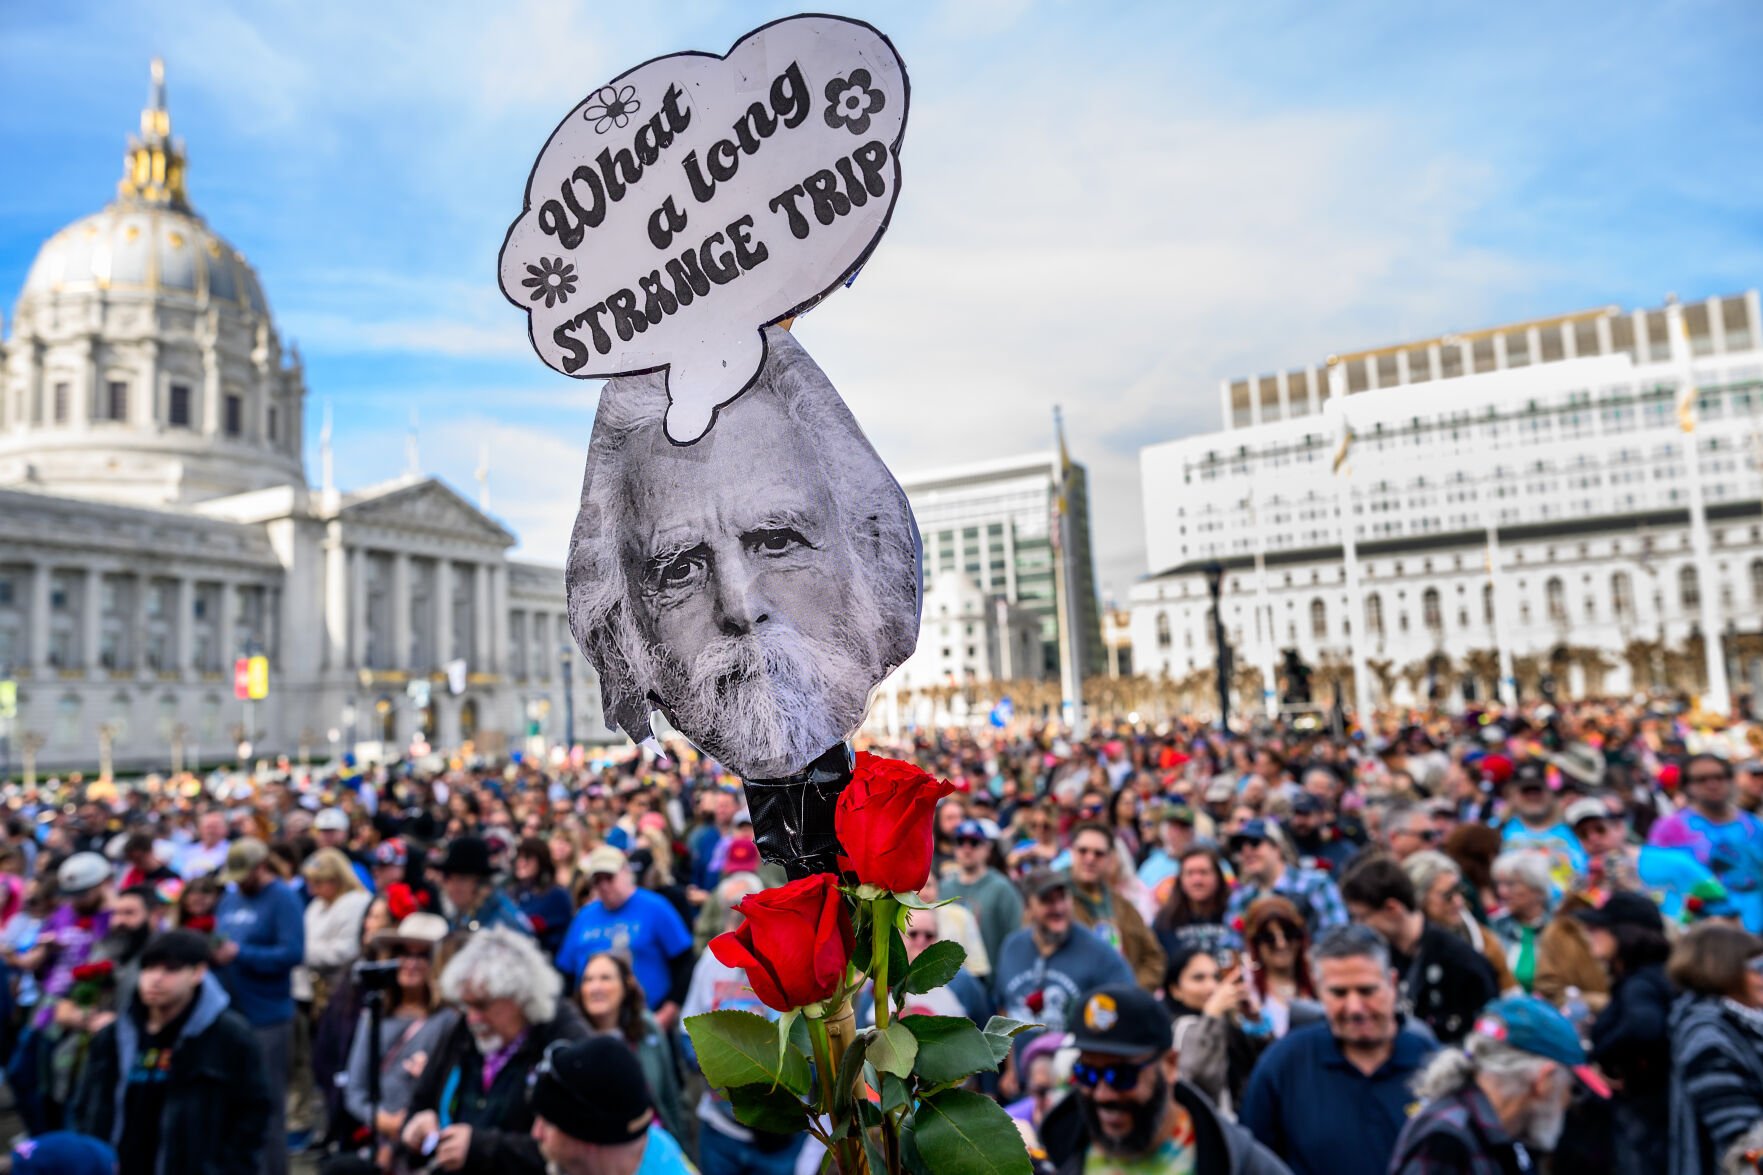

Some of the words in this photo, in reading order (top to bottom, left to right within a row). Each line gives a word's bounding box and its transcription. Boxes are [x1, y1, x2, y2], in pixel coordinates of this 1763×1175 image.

[538, 82, 691, 250] What
[647, 195, 688, 249] a
[682, 61, 811, 203] long
[553, 214, 769, 374] STRANGE
[769, 140, 888, 240] TRIP
